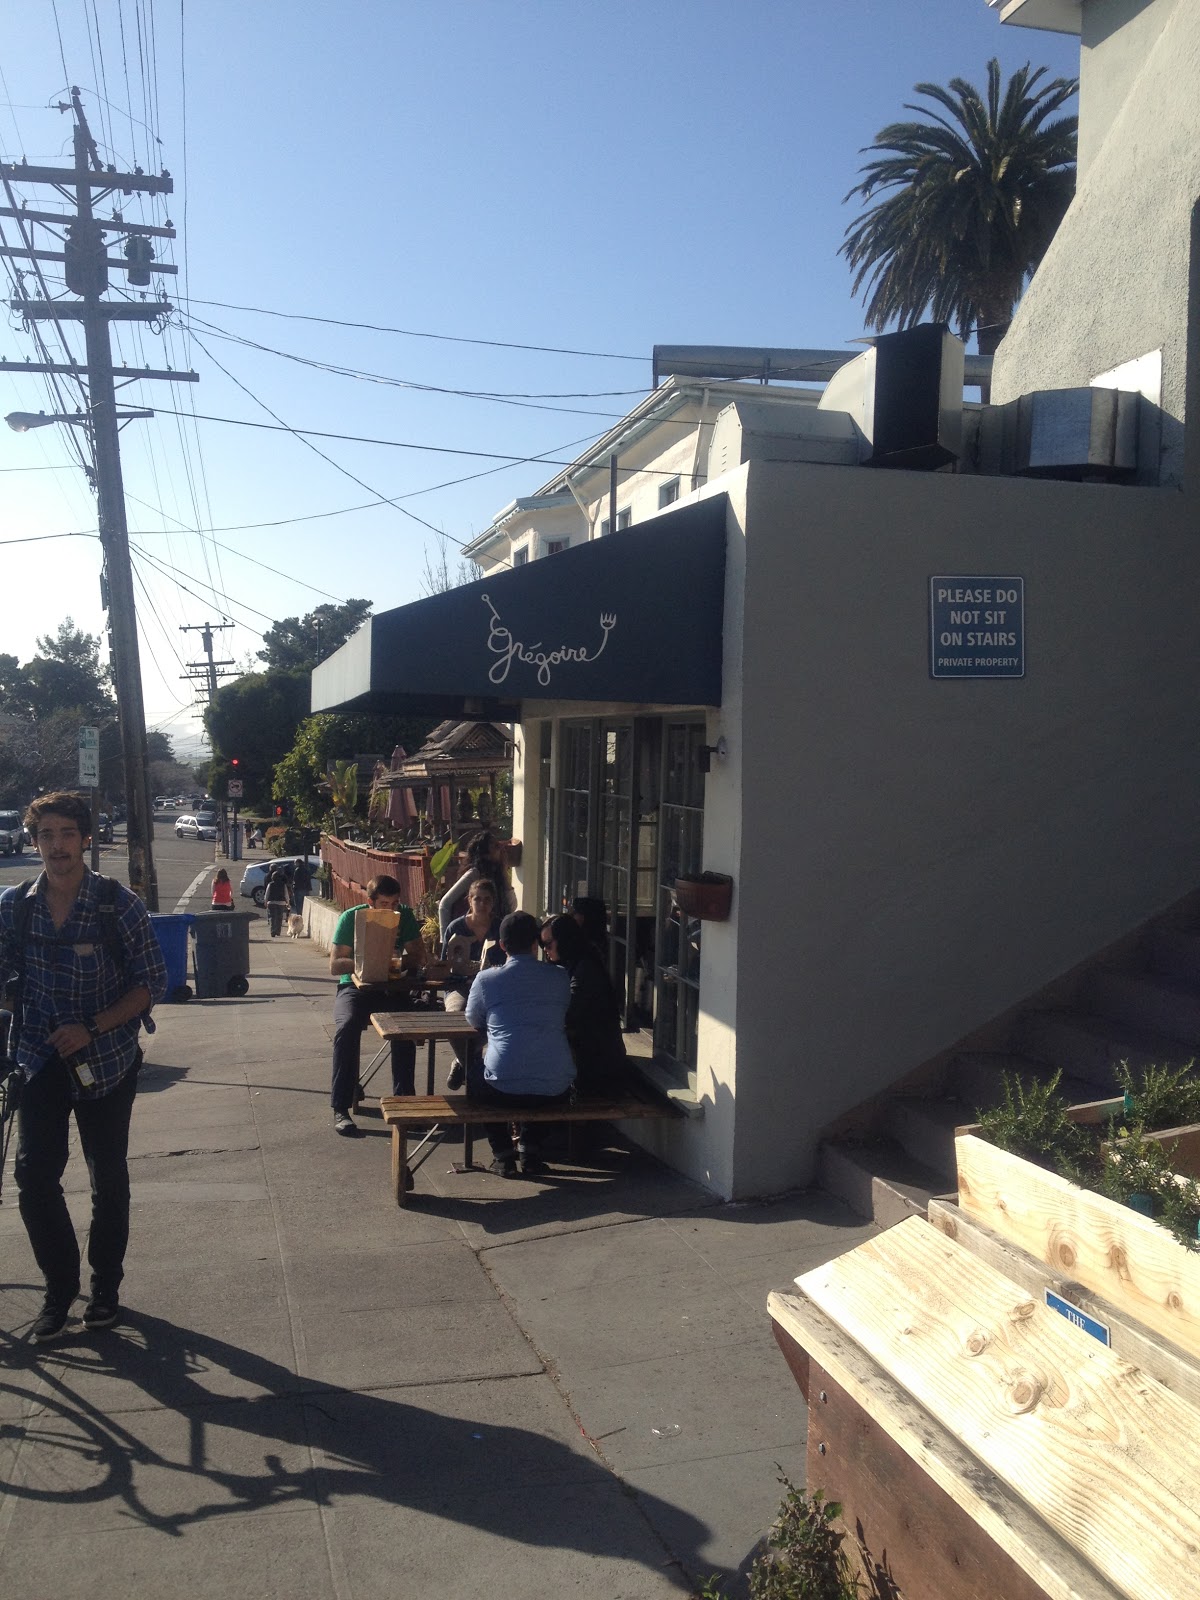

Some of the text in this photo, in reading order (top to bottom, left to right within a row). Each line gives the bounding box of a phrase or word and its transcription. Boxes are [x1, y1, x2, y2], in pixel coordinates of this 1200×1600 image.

[938, 589, 1018, 603] PLEASE DO
[950, 610, 1007, 625] NOT SIT
[940, 632, 1017, 646] ON STAIRS
[938, 657, 1019, 667] PRIVATE PROPERTY
[1065, 1308, 1086, 1331] THE
